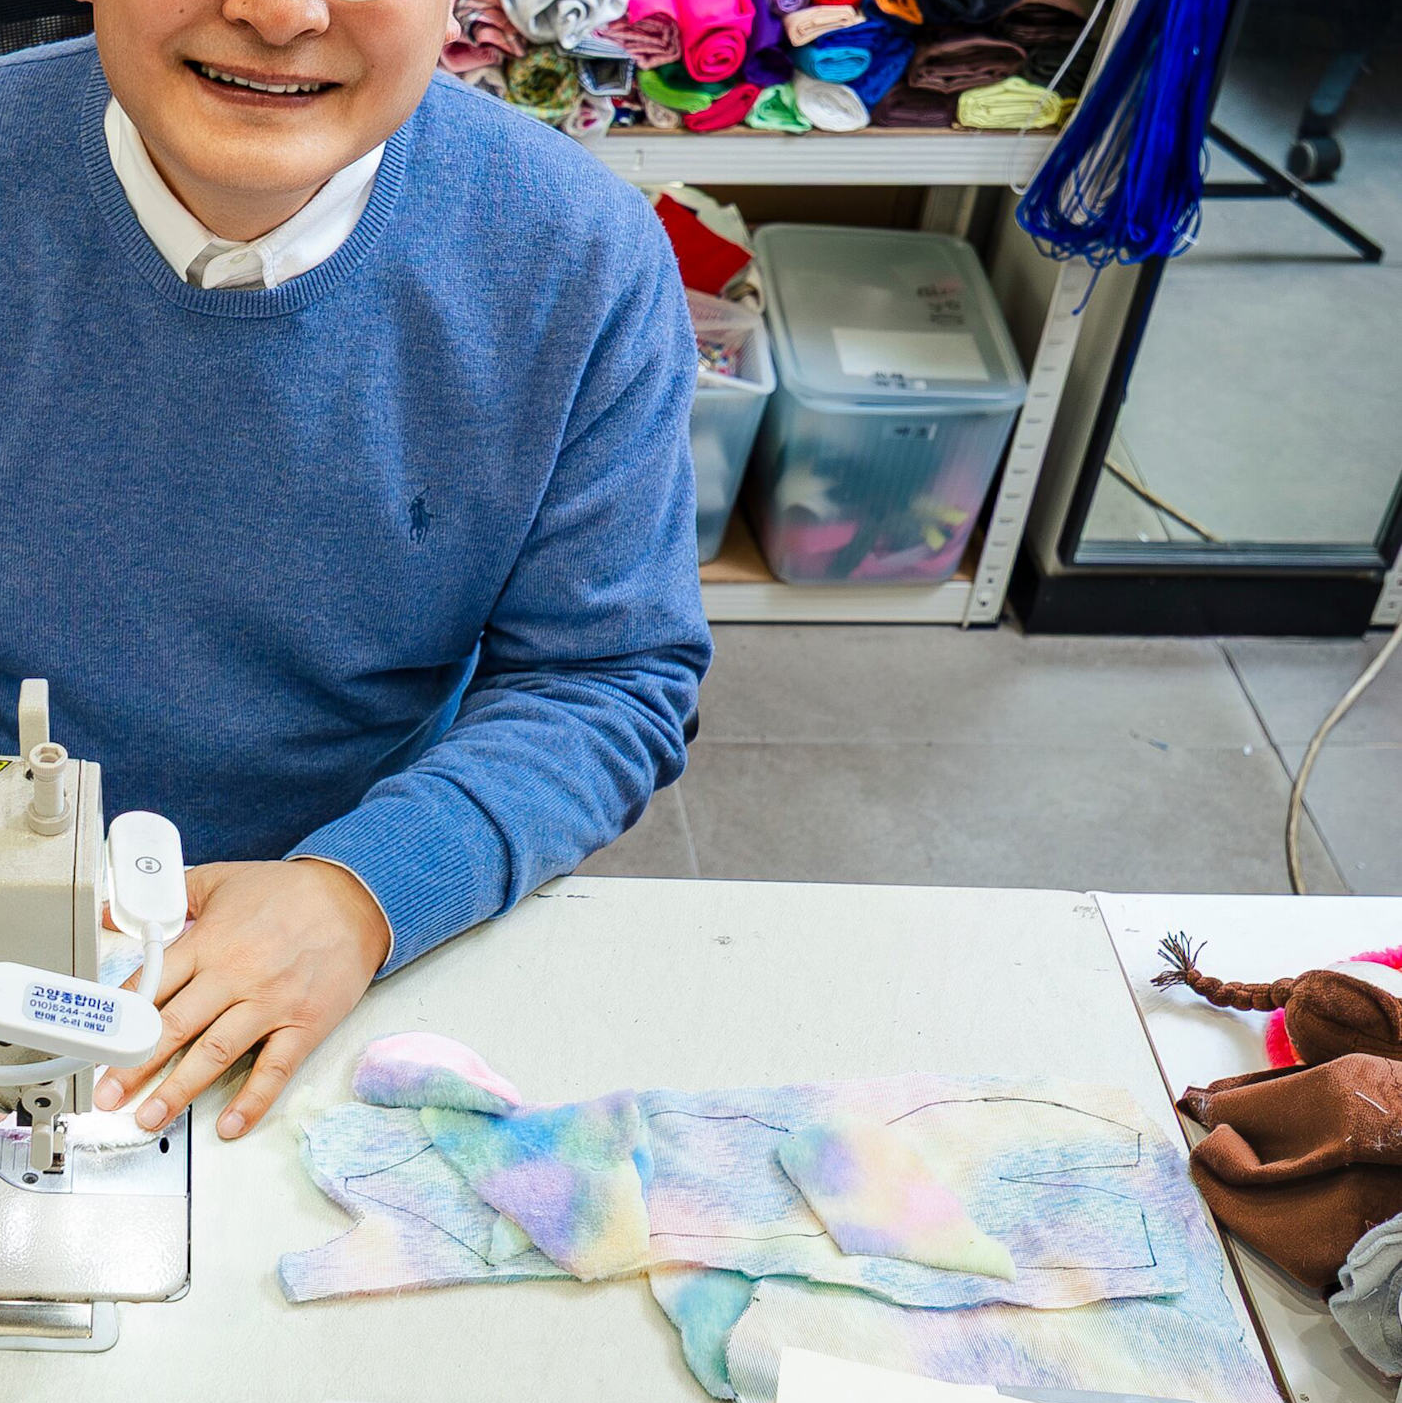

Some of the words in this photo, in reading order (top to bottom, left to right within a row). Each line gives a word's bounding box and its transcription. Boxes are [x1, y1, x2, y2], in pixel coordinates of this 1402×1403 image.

[31, 985, 115, 1013] 고양종합미싱
[34, 1010, 57, 1022] 판매
[60, 1016, 81, 1028] 수리
[84, 1021, 106, 1032] 매입
